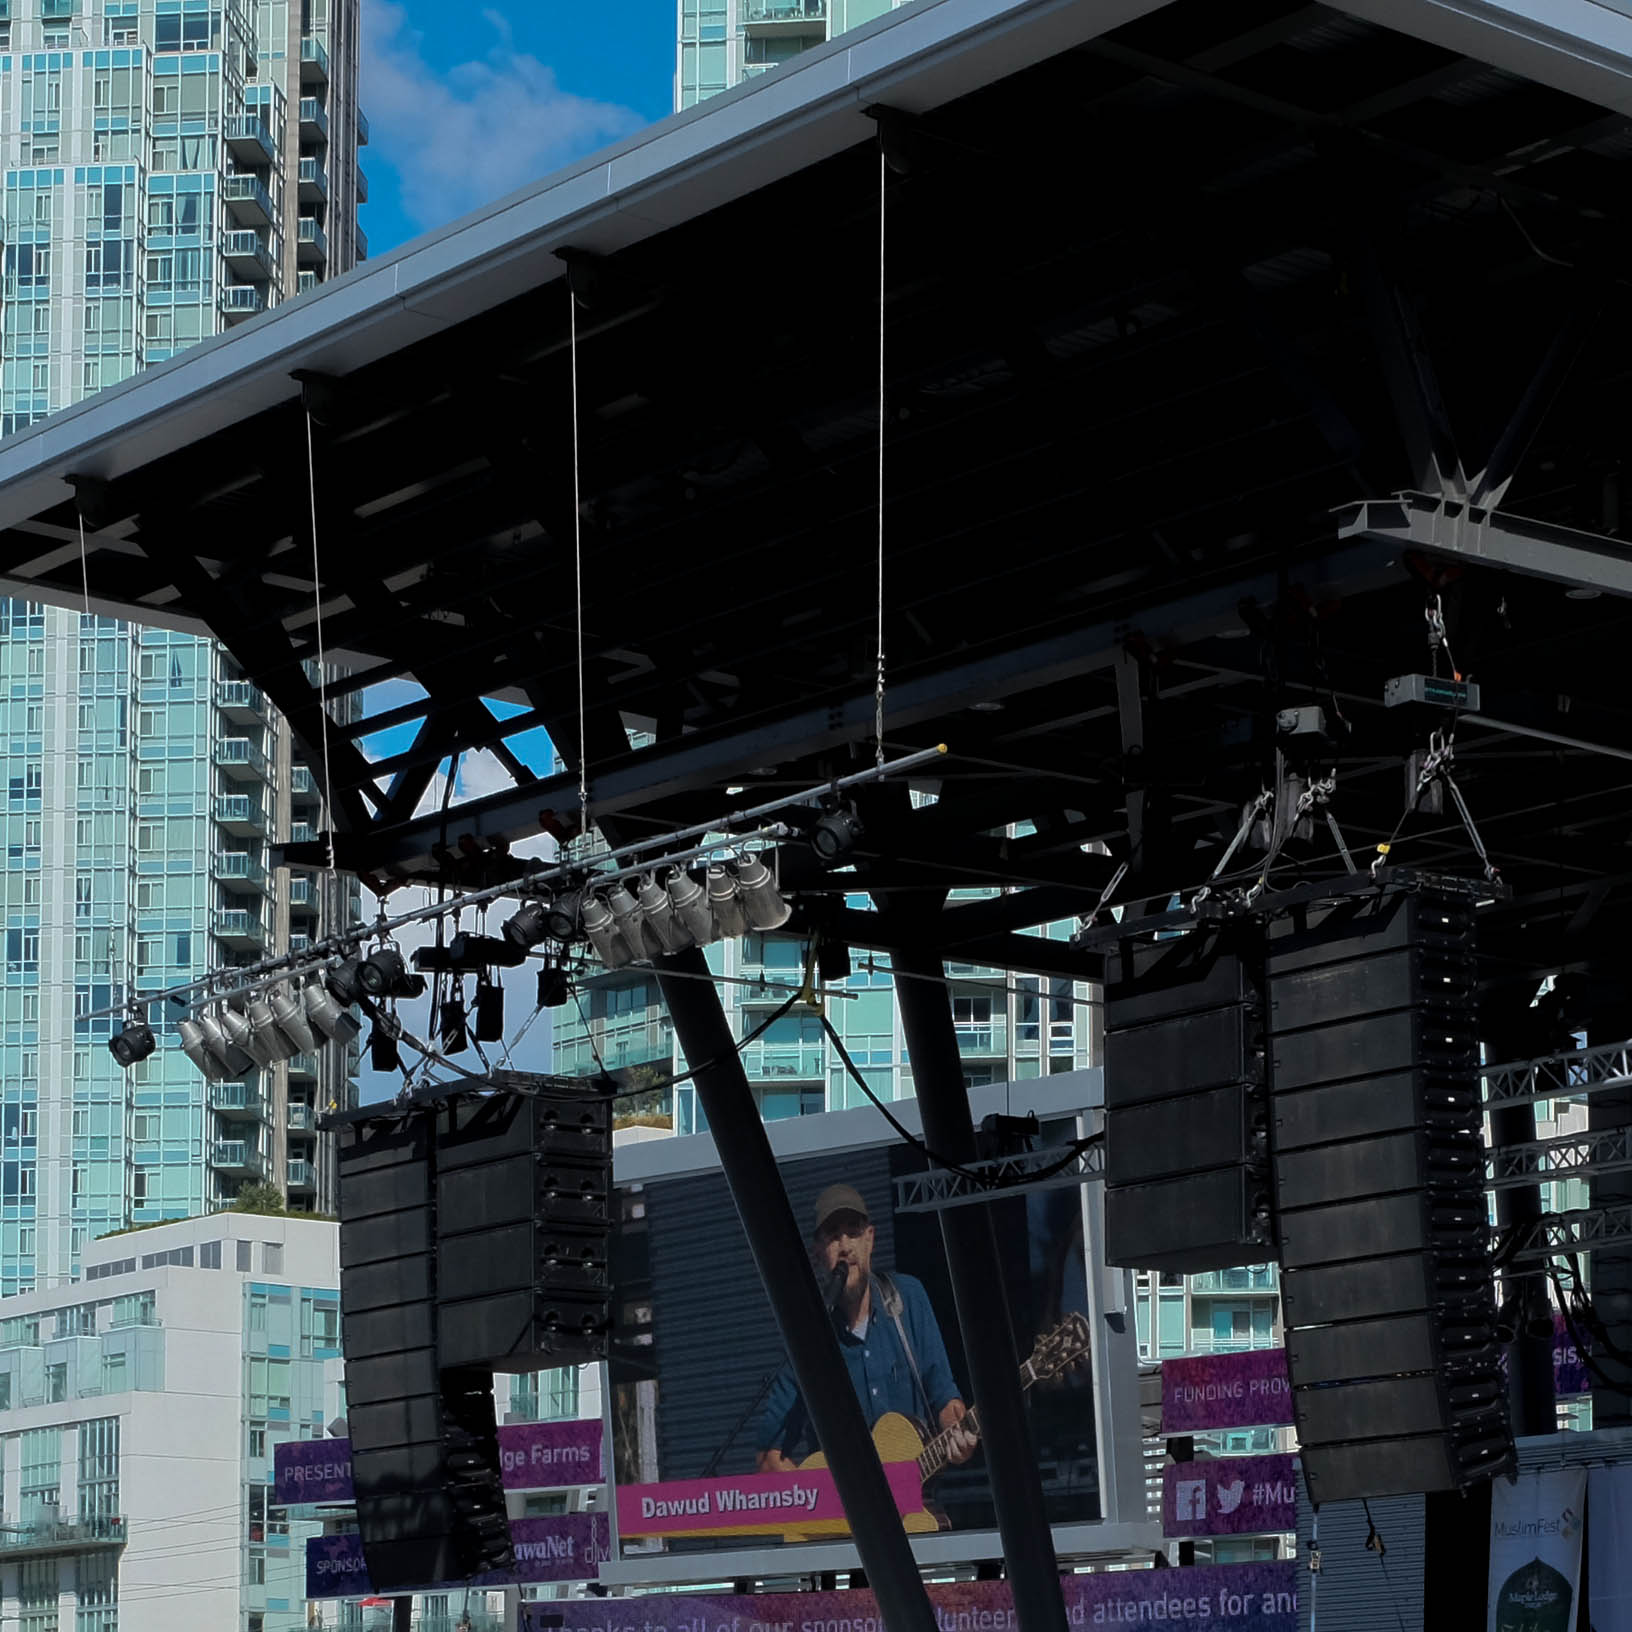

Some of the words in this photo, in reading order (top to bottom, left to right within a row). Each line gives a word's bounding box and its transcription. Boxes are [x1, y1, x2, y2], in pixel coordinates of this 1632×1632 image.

[1174, 1381, 1244, 1403] FUNDING
[1249, 1377, 1290, 1397] PROV
[531, 1444, 591, 1466] Farms
[284, 1461, 352, 1484] PRESENT
[641, 1491, 710, 1519] Dawud
[715, 1484, 819, 1512] Wharnsby
[1252, 1481, 1296, 1506] #Mu
[1495, 1518, 1561, 1537] MuslimFest
[513, 1536, 575, 1561] awaNet
[936, 1606, 1017, 1632] lunteer
[1093, 1592, 1212, 1625] attendees
[1220, 1587, 1255, 1617] for
[1262, 1592, 1297, 1614] an
